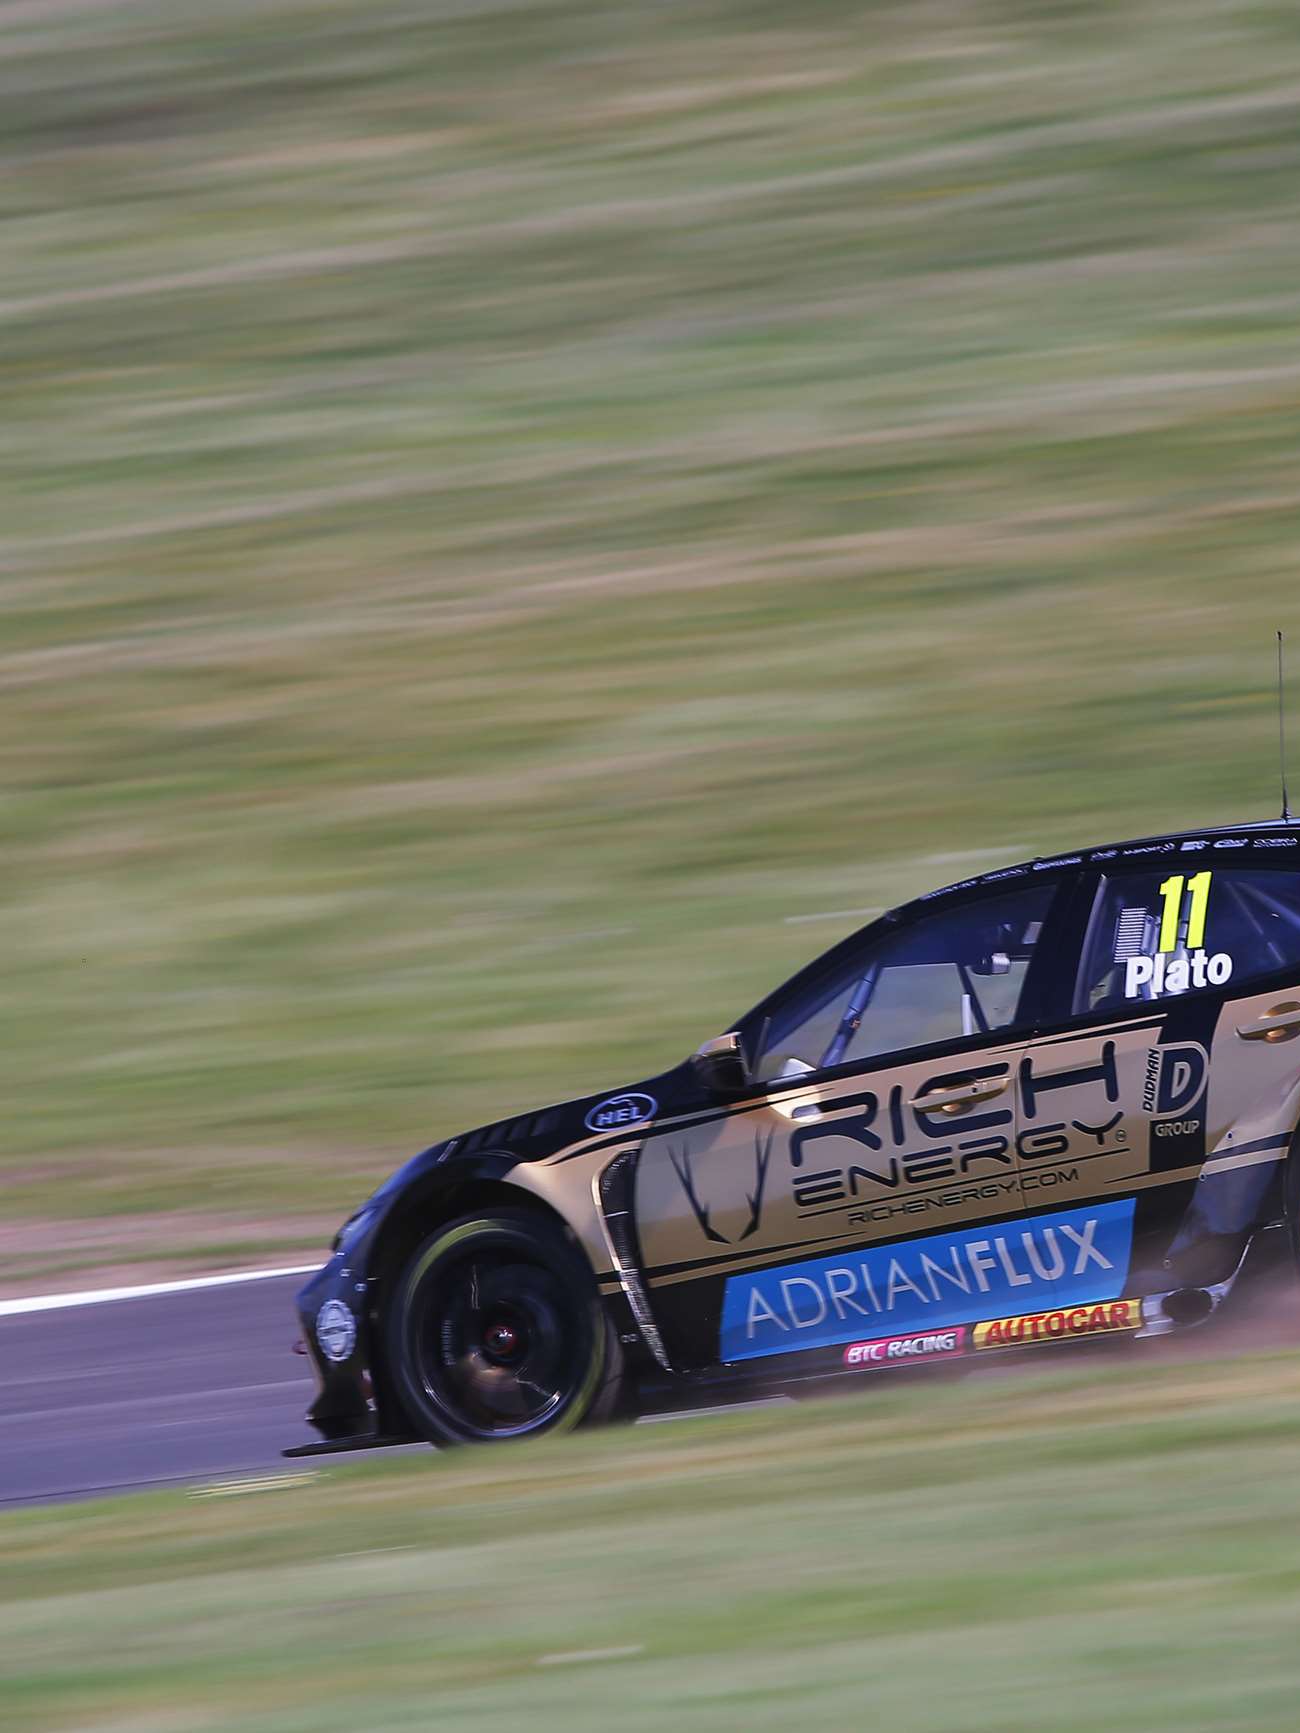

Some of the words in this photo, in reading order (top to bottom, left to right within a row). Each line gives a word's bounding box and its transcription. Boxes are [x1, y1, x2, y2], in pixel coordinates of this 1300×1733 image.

[1159, 871, 1212, 953] 11
[1125, 949, 1233, 999] Plato
[790, 1040, 1120, 1167] RICH
[1143, 1048, 1160, 1112] DUDMAN
[596, 1106, 643, 1126] HEL
[1155, 1120, 1200, 1137] GROUP
[792, 1110, 1125, 1207] ENERGY
[848, 1168, 1080, 1227] RICHENERGY.COM
[746, 1219, 1114, 1340] ADRIANFLUX
[848, 1343, 886, 1364] BTC
[887, 1332, 957, 1358] RACING
[985, 1302, 1131, 1347] AUTOCAR
